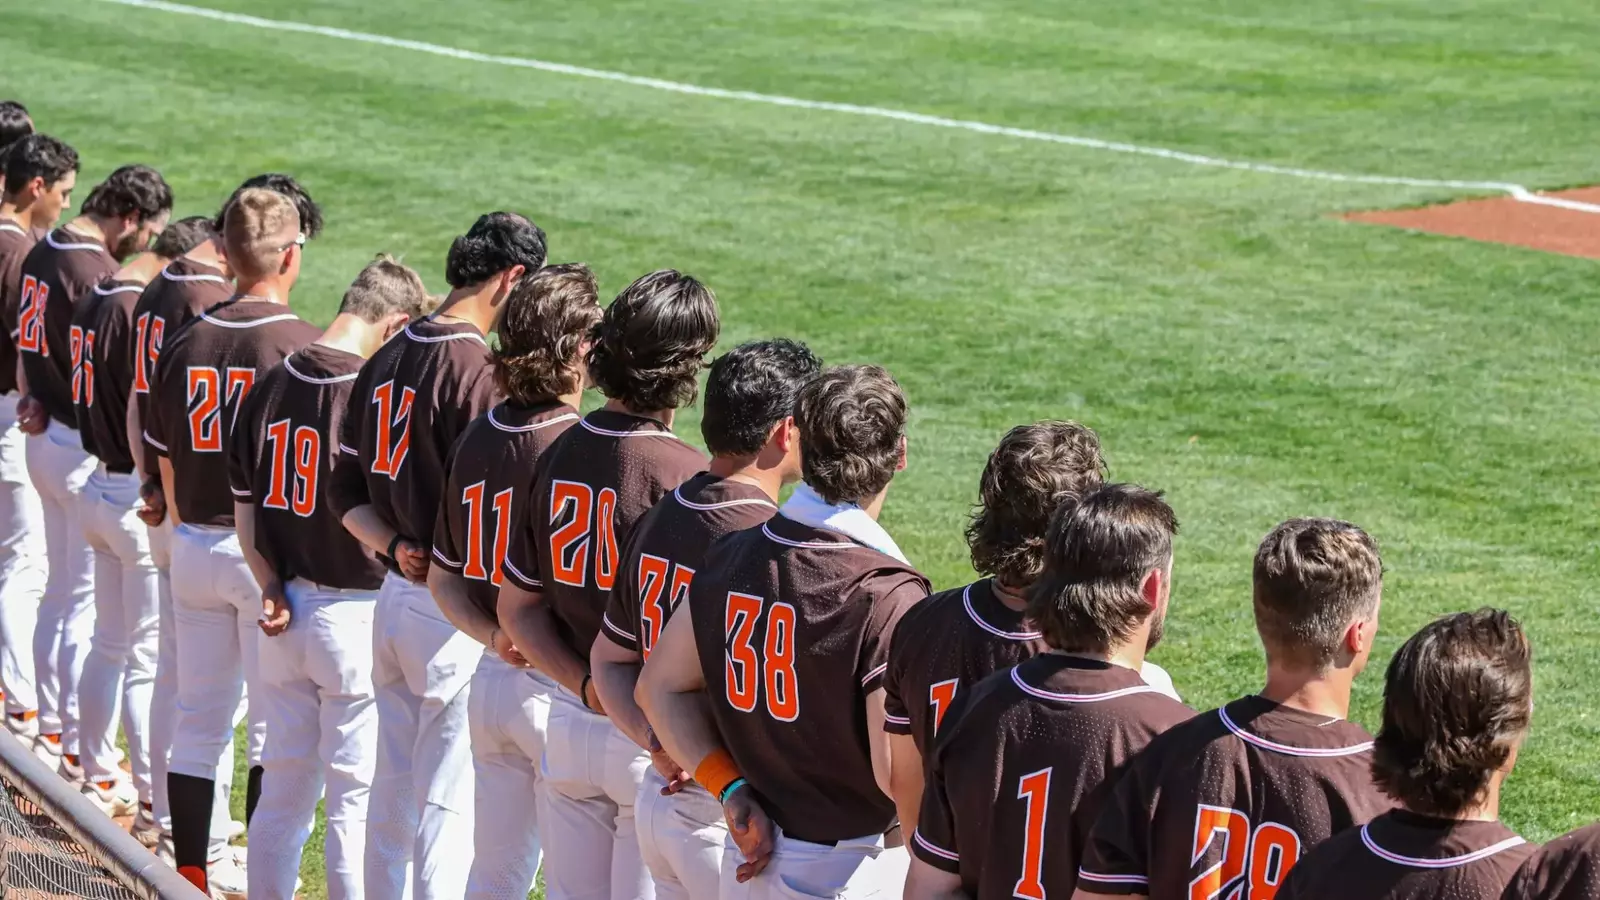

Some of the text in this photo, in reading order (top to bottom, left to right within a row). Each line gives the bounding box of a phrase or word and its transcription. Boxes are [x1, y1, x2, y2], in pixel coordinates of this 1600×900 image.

[187, 366, 256, 452] 27
[371, 379, 416, 481] 17
[263, 418, 320, 518] 19
[462, 480, 513, 588] 11
[550, 480, 619, 591] 20
[725, 591, 800, 722] 38
[1012, 766, 1053, 900] 1
